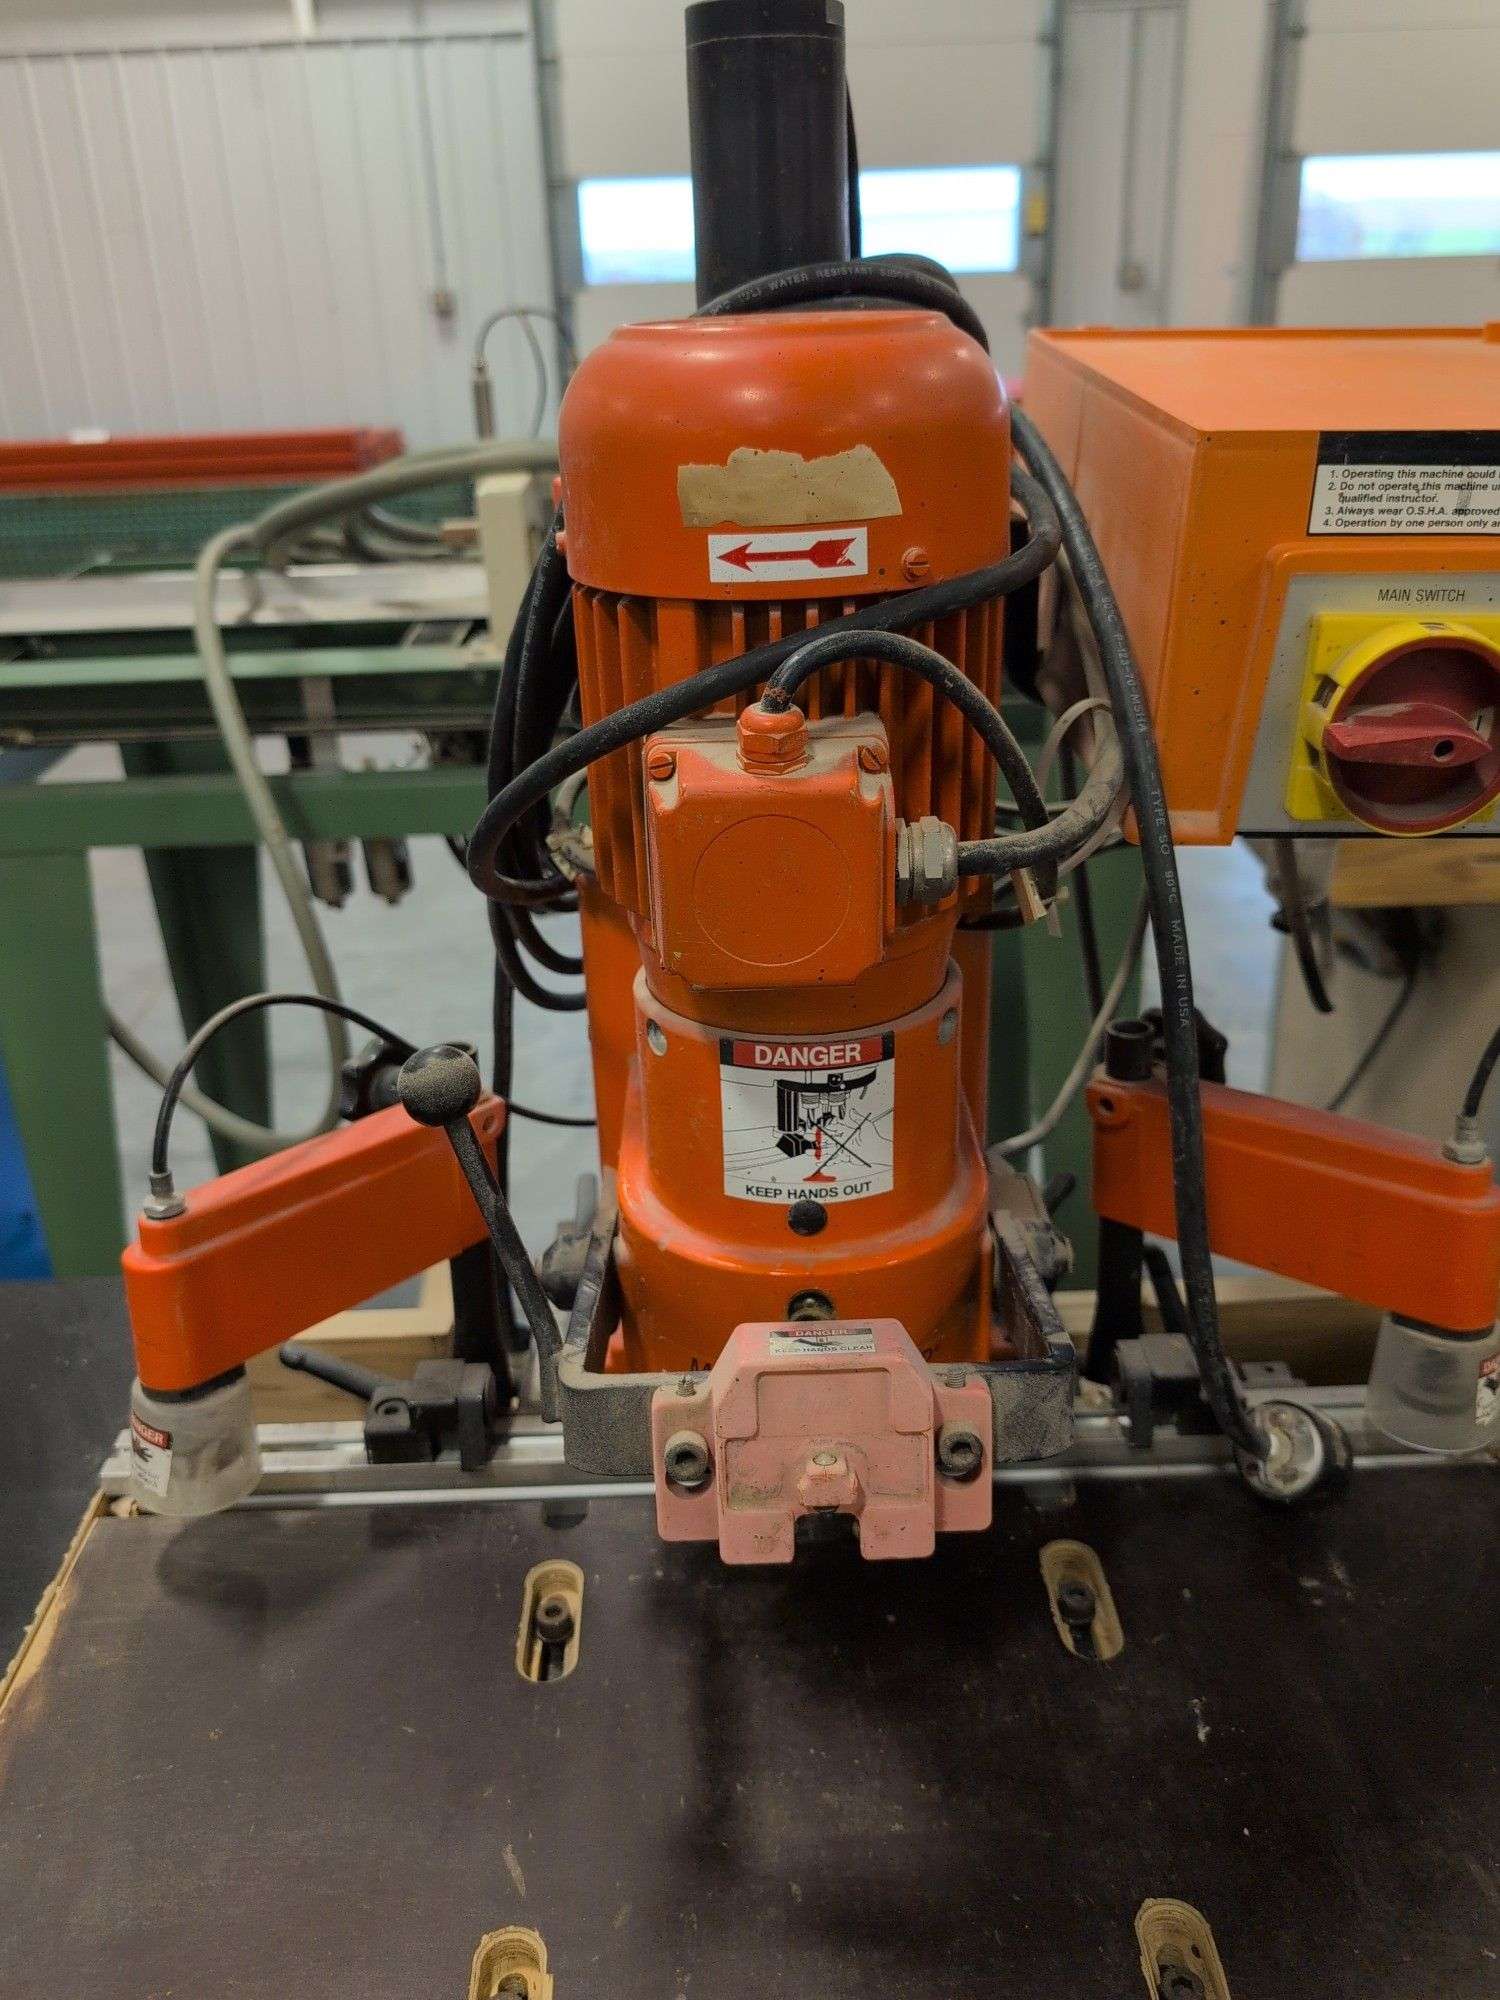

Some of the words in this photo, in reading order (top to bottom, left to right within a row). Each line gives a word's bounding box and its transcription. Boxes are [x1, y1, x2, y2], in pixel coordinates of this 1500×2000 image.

[768, 272, 809, 290] WATER
[1330, 470, 1338, 479] 1.
[1342, 469, 1394, 480] Operating
[1397, 469, 1417, 479] this
[1419, 469, 1464, 479] machine
[1467, 469, 1496, 479] could
[1340, 483, 1355, 491] Do
[1358, 483, 1375, 491] not
[1378, 483, 1418, 493] operate
[1421, 482, 1441, 491] this
[1444, 483, 1489, 491] machine
[1338, 493, 1383, 505] qualified
[1386, 493, 1438, 503] instructor.
[1325, 507, 1334, 515] 3.
[1337, 507, 1374, 517] Always
[1378, 508, 1402, 516] wear
[1406, 507, 1447, 516] O.S.H.A.
[1451, 506, 1500, 517] approved
[1323, 519, 1332, 528] 4.
[1335, 519, 1387, 529] Operation
[1390, 519, 1401, 529] by
[1405, 520, 1425, 528] one
[1427, 520, 1464, 530] person
[1466, 519, 1488, 529] only
[1377, 589, 1412, 602] MAIN
[1415, 589, 1466, 602] SWITCH
[1151, 789, 1166, 827] TYPE
[1171, 919, 1185, 967] MADE
[1175, 973, 1187, 990] IN
[1177, 996, 1192, 1031] USA
[754, 1043, 862, 1066] DANGER
[745, 1184, 783, 1197] KEEP
[787, 1186, 839, 1200] HANDS
[843, 1182, 872, 1196] OUT
[794, 1328, 850, 1337] DANGER
[803, 1345, 838, 1353] HANDS
[839, 1344, 873, 1352] CLEAR
